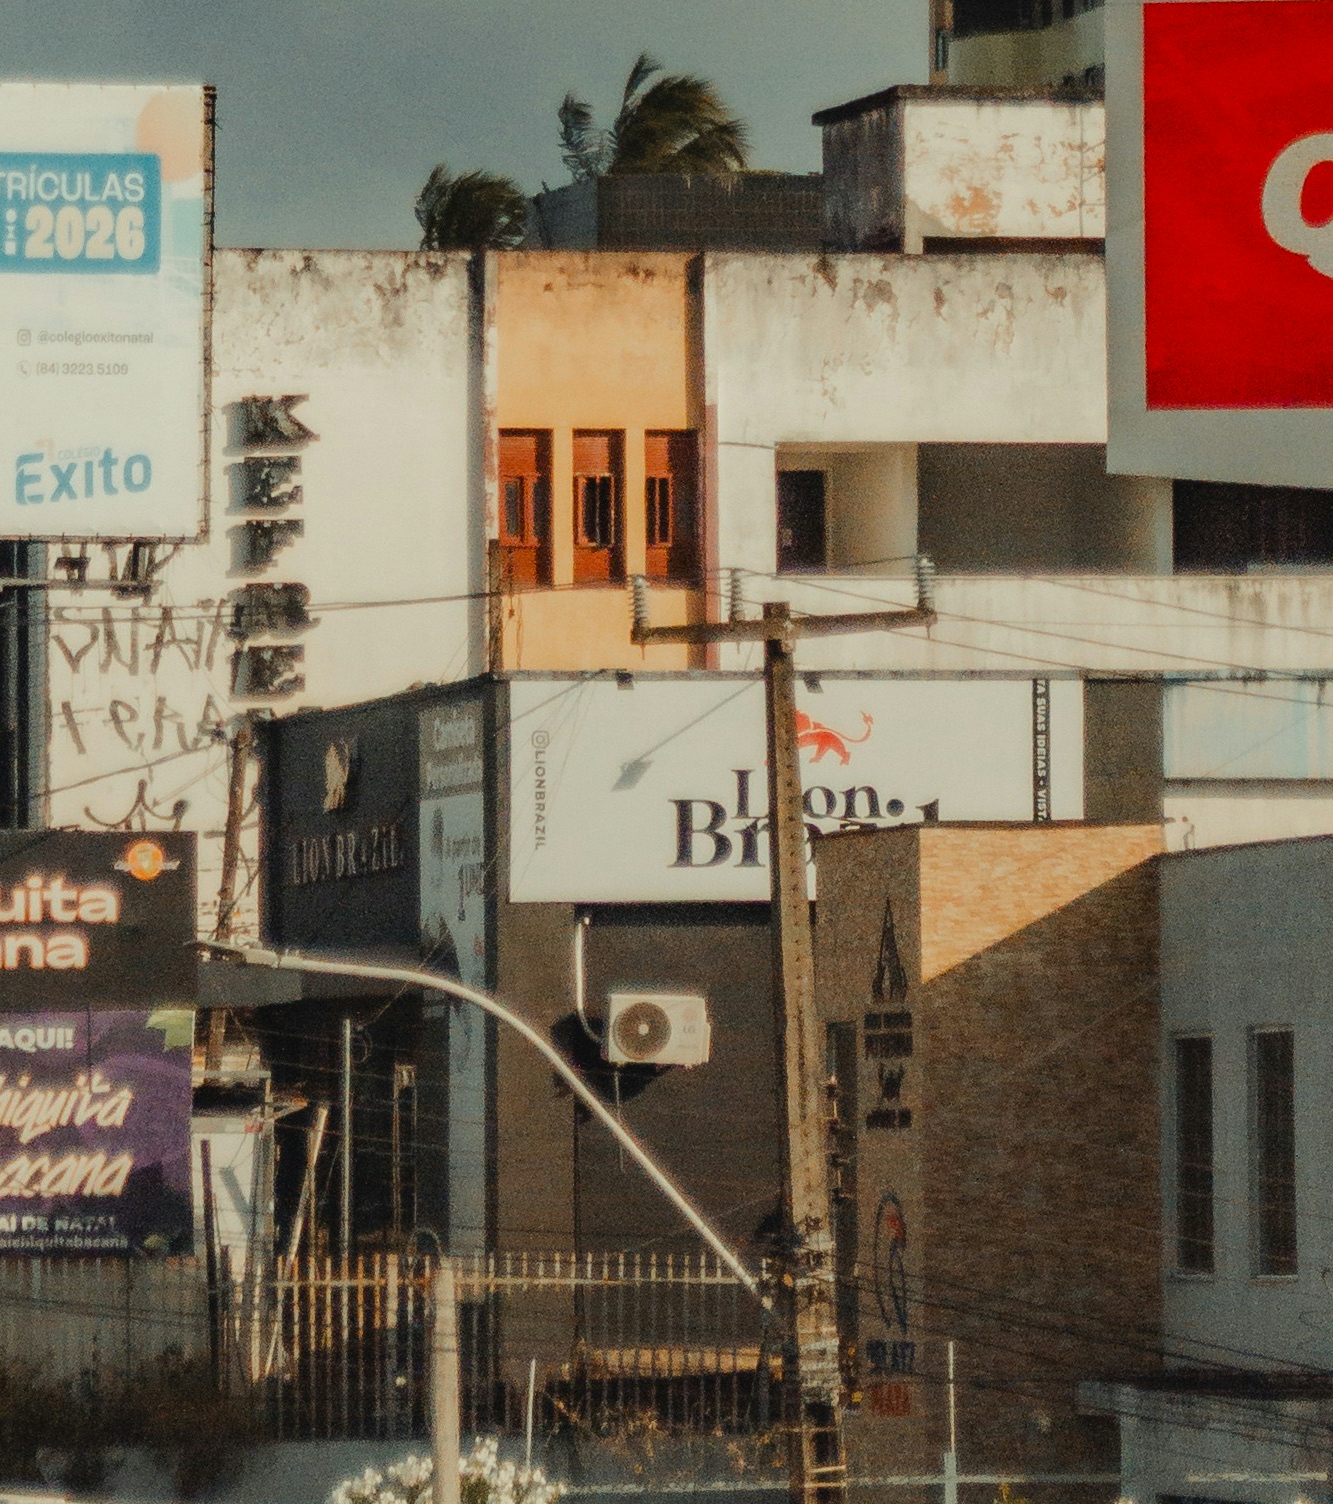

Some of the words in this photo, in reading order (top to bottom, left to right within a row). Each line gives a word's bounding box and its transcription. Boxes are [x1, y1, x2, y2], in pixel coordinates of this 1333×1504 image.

[24, 205, 146, 260] 2026
[37, 330, 154, 346] @colegioexitonatal
[36, 361, 60, 377] (84)
[1036, 697, 1046, 732] SUAS
[1036, 734, 1046, 777] IDEIAS
[534, 750, 546, 850] LIONBRAZIL
[730, 768, 886, 820] Lon
[21, 1215, 49, 1231] DE
